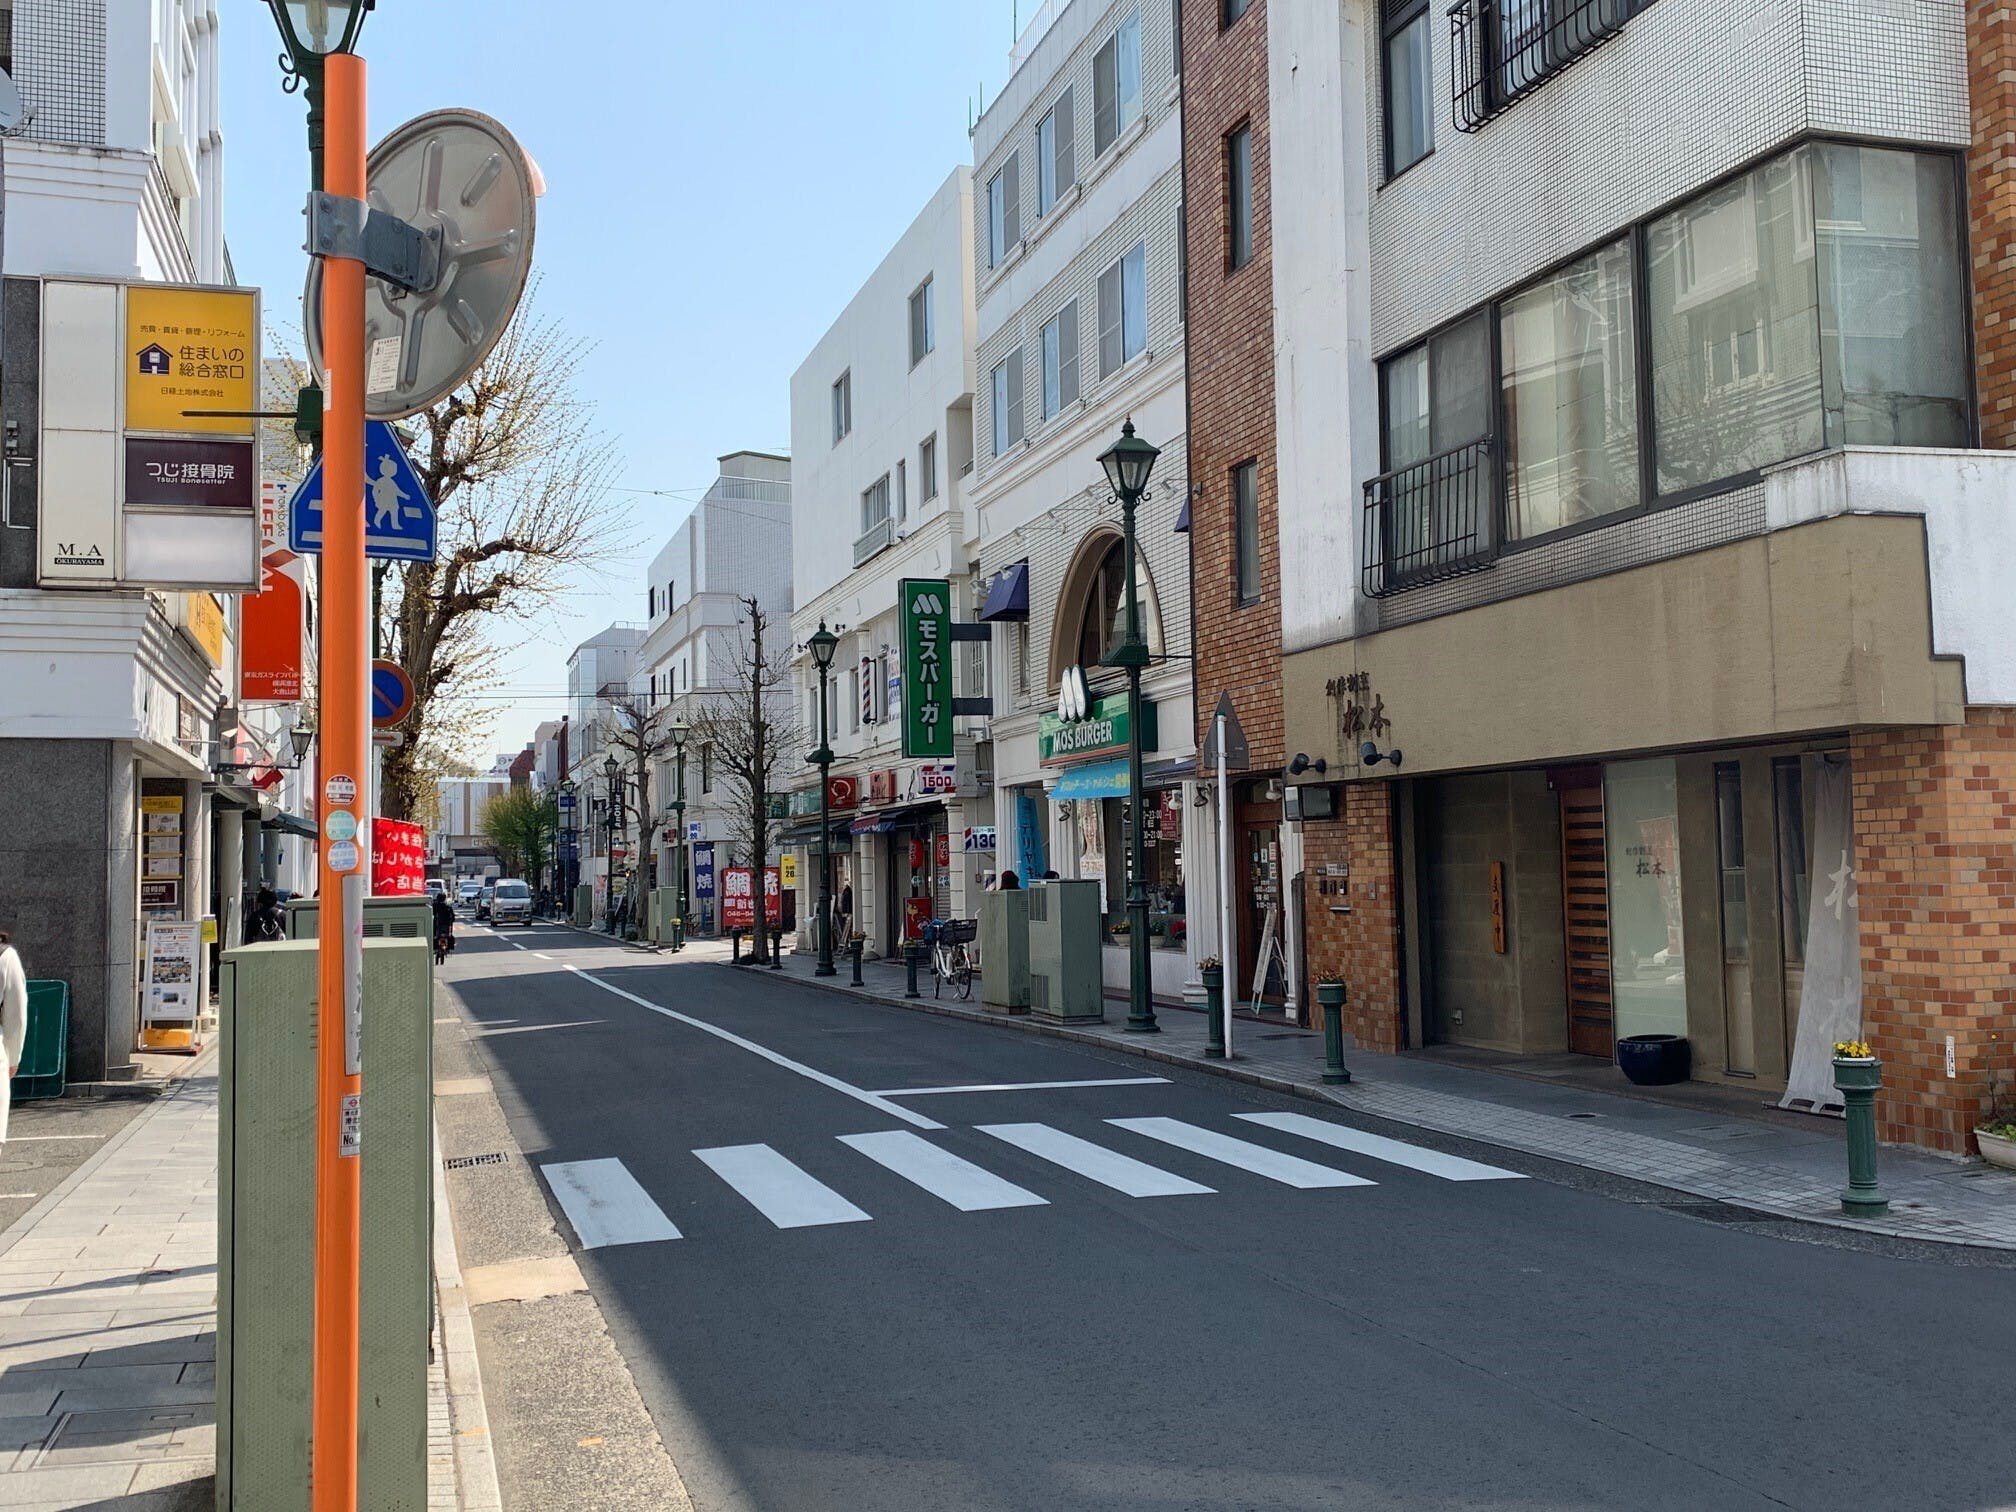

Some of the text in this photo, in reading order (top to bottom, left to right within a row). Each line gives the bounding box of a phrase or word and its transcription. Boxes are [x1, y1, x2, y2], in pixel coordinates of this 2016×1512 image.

[179, 346, 244, 362] 住まいの
[179, 364, 244, 379] 総合窓口
[146, 463, 234, 480] つじ接骨院
[918, 619, 941, 744] モスバーガー
[1053, 720, 1112, 752] MOS BURGER
[923, 776, 951, 787] 1500
[695, 850, 712, 889] 鯛焼
